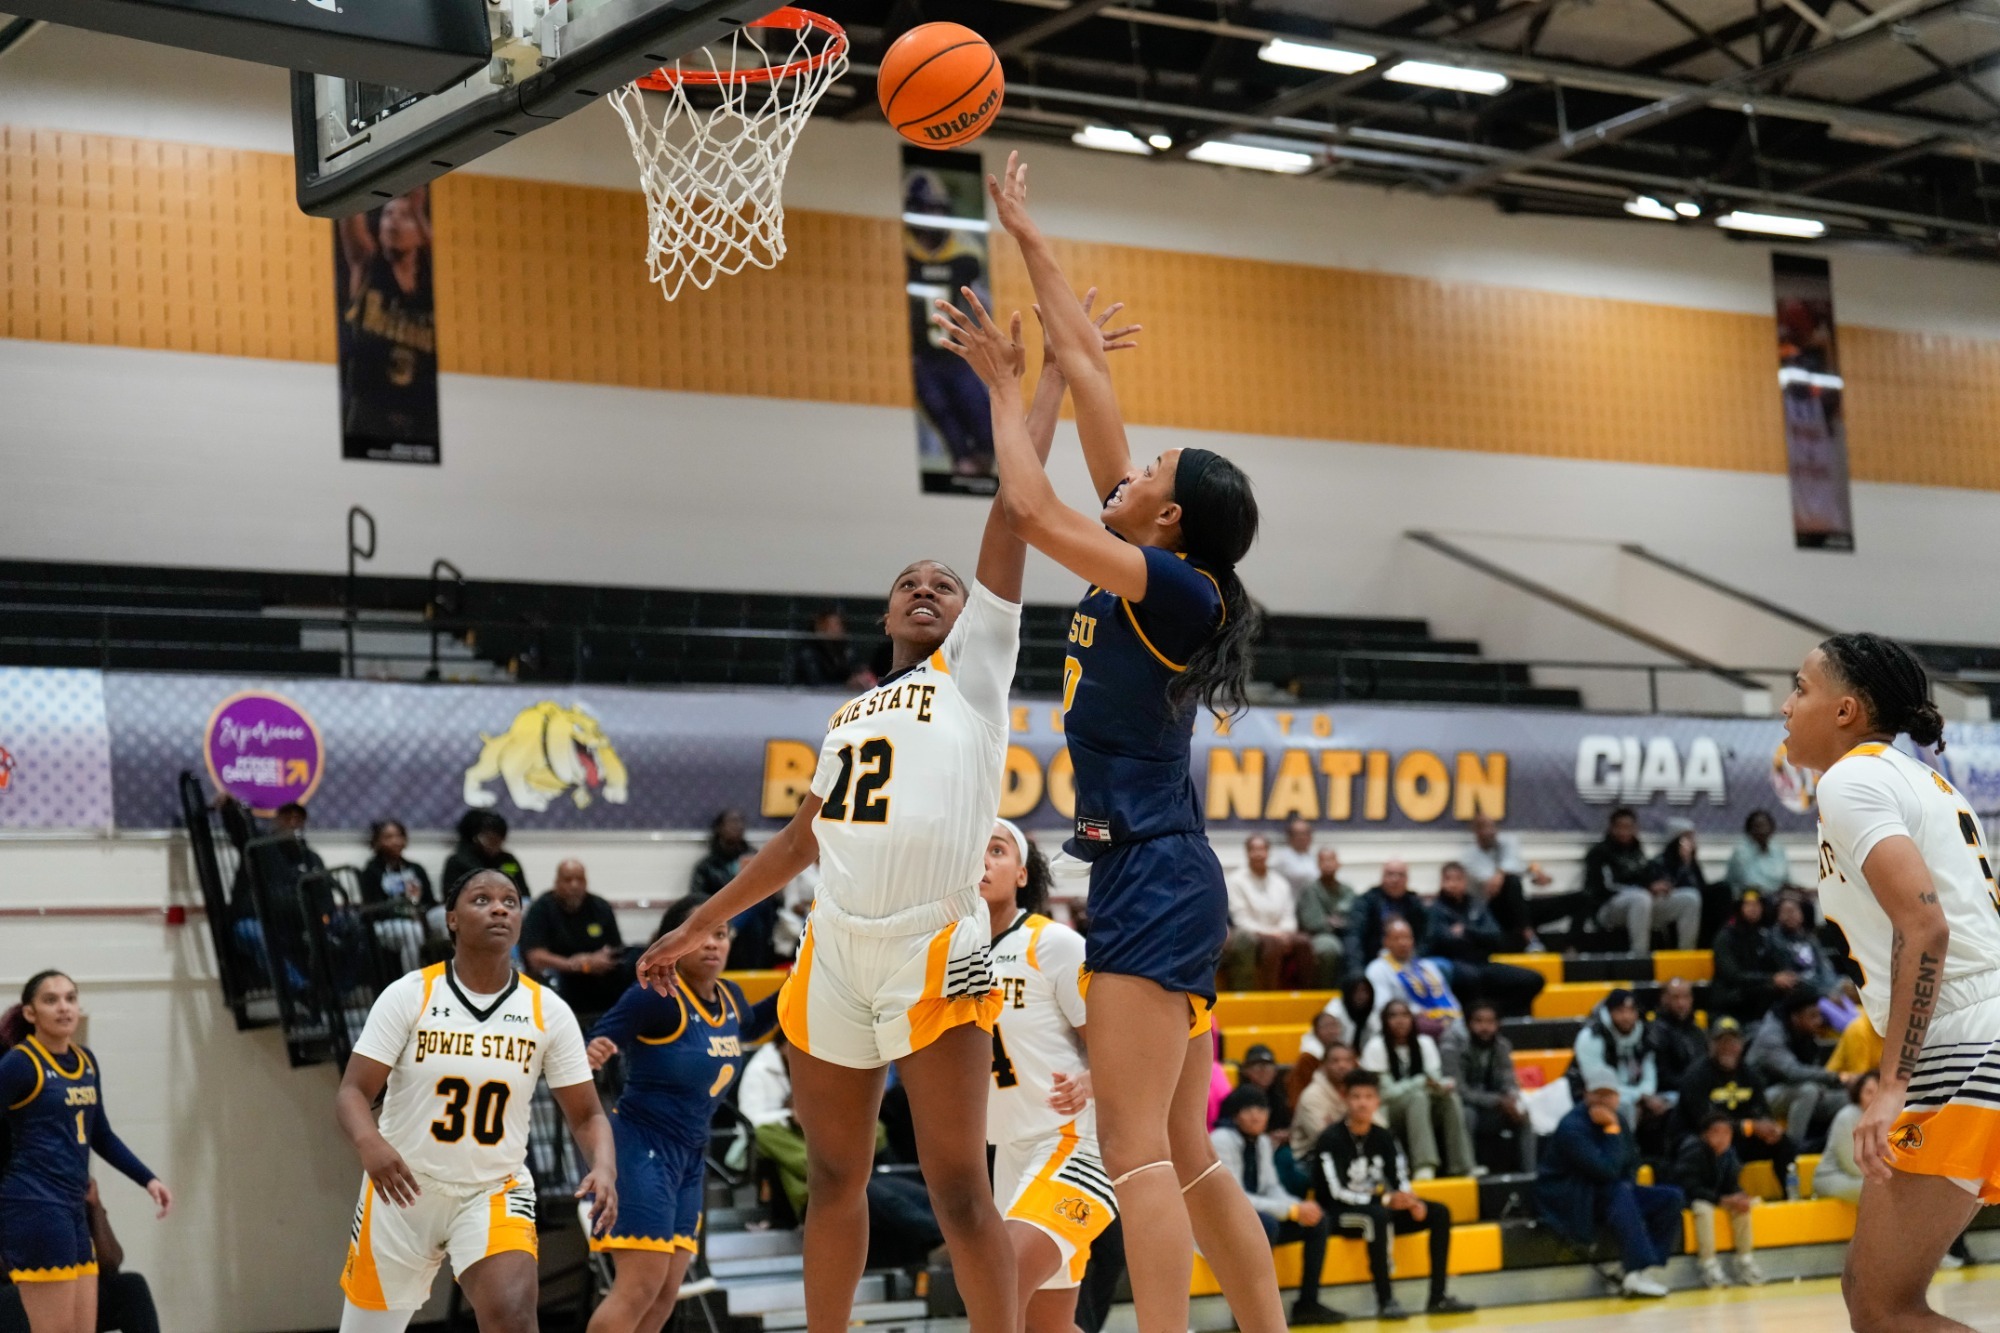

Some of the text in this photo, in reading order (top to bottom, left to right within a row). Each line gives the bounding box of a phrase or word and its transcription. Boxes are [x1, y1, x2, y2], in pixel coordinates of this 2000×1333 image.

[923, 89, 998, 140] Wilson
[1068, 611, 1098, 648] SU
[866, 683, 936, 723] STATE
[819, 735, 895, 825] 12
[1204, 747, 1508, 822] NATION
[1574, 733, 1727, 806] CIAA
[503, 1013, 530, 1025] CIAA
[415, 1030, 537, 1075] BOWIE STATE
[707, 1035, 741, 1057] JCSU
[75, 1109, 87, 1145] 1
[430, 1075, 511, 1146] 30
